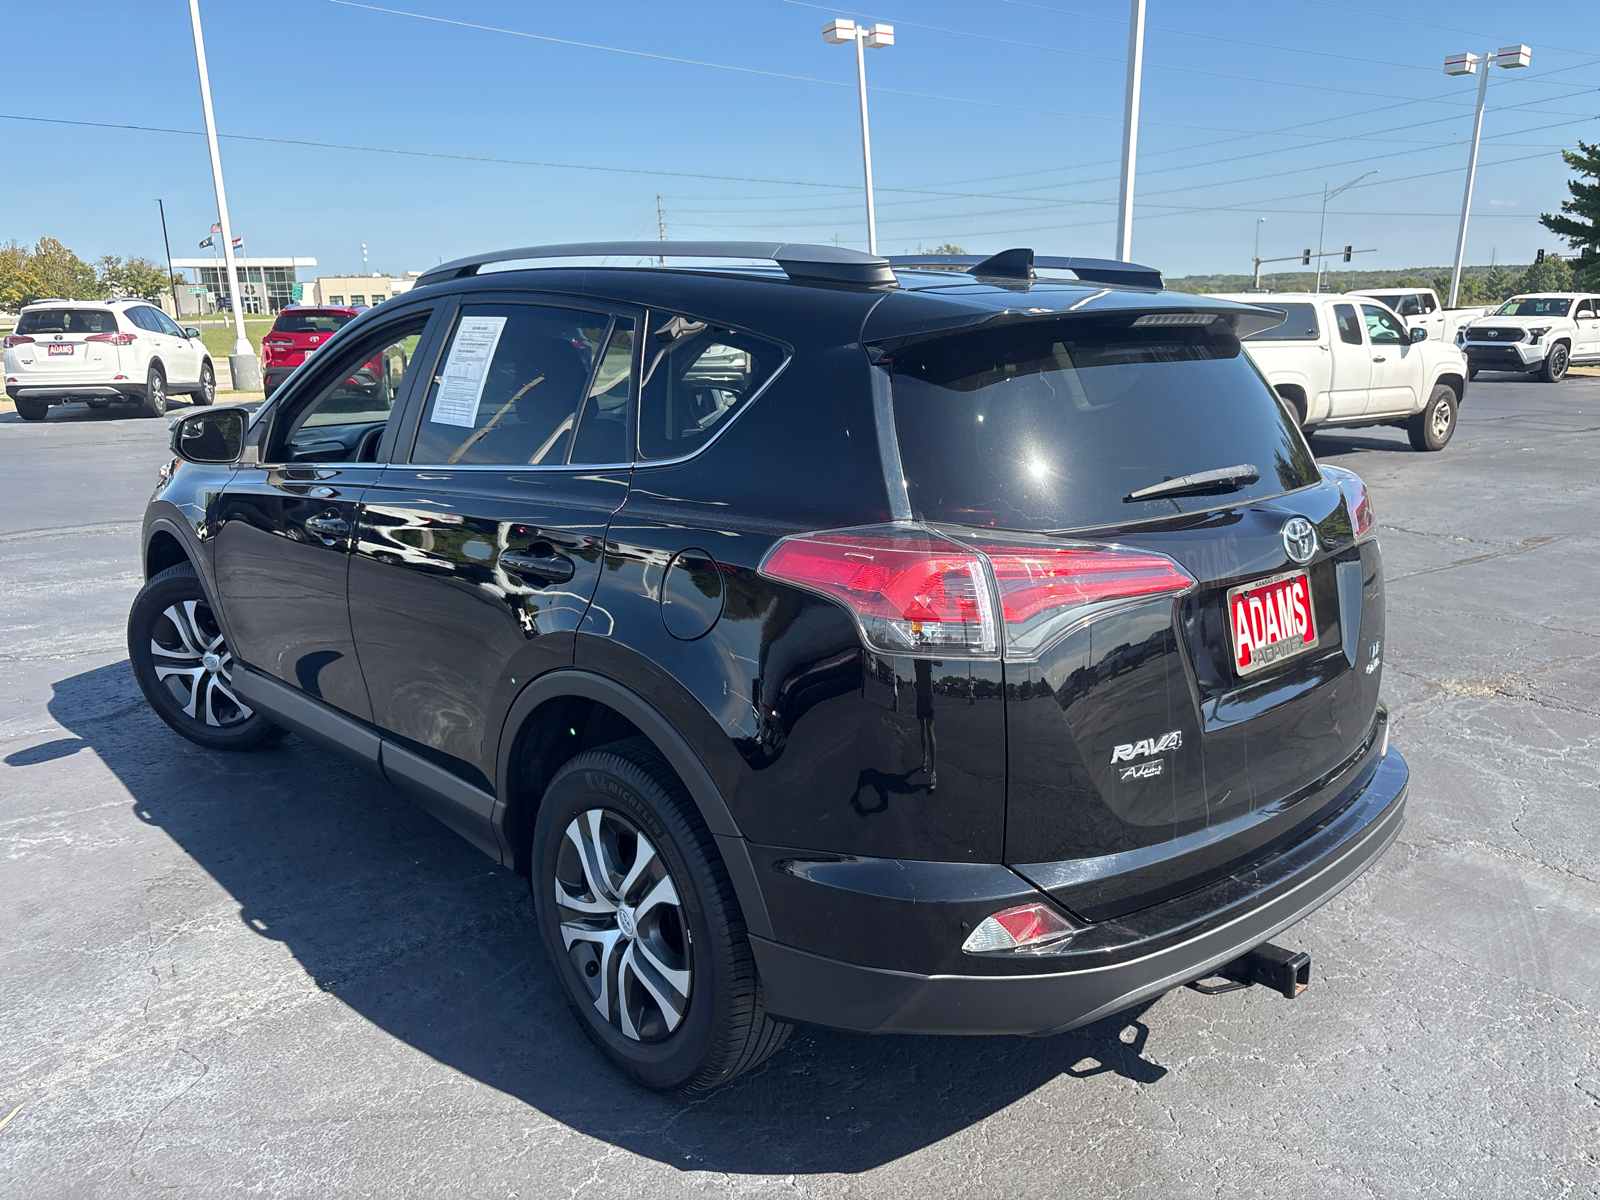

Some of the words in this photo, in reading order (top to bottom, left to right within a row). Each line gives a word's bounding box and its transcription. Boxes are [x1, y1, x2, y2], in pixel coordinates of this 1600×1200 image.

[49, 345, 73, 355] ADAMS
[1236, 582, 1308, 660] ADAMS
[1110, 730, 1182, 764] RAV4
[608, 782, 663, 836] MICHELIN
